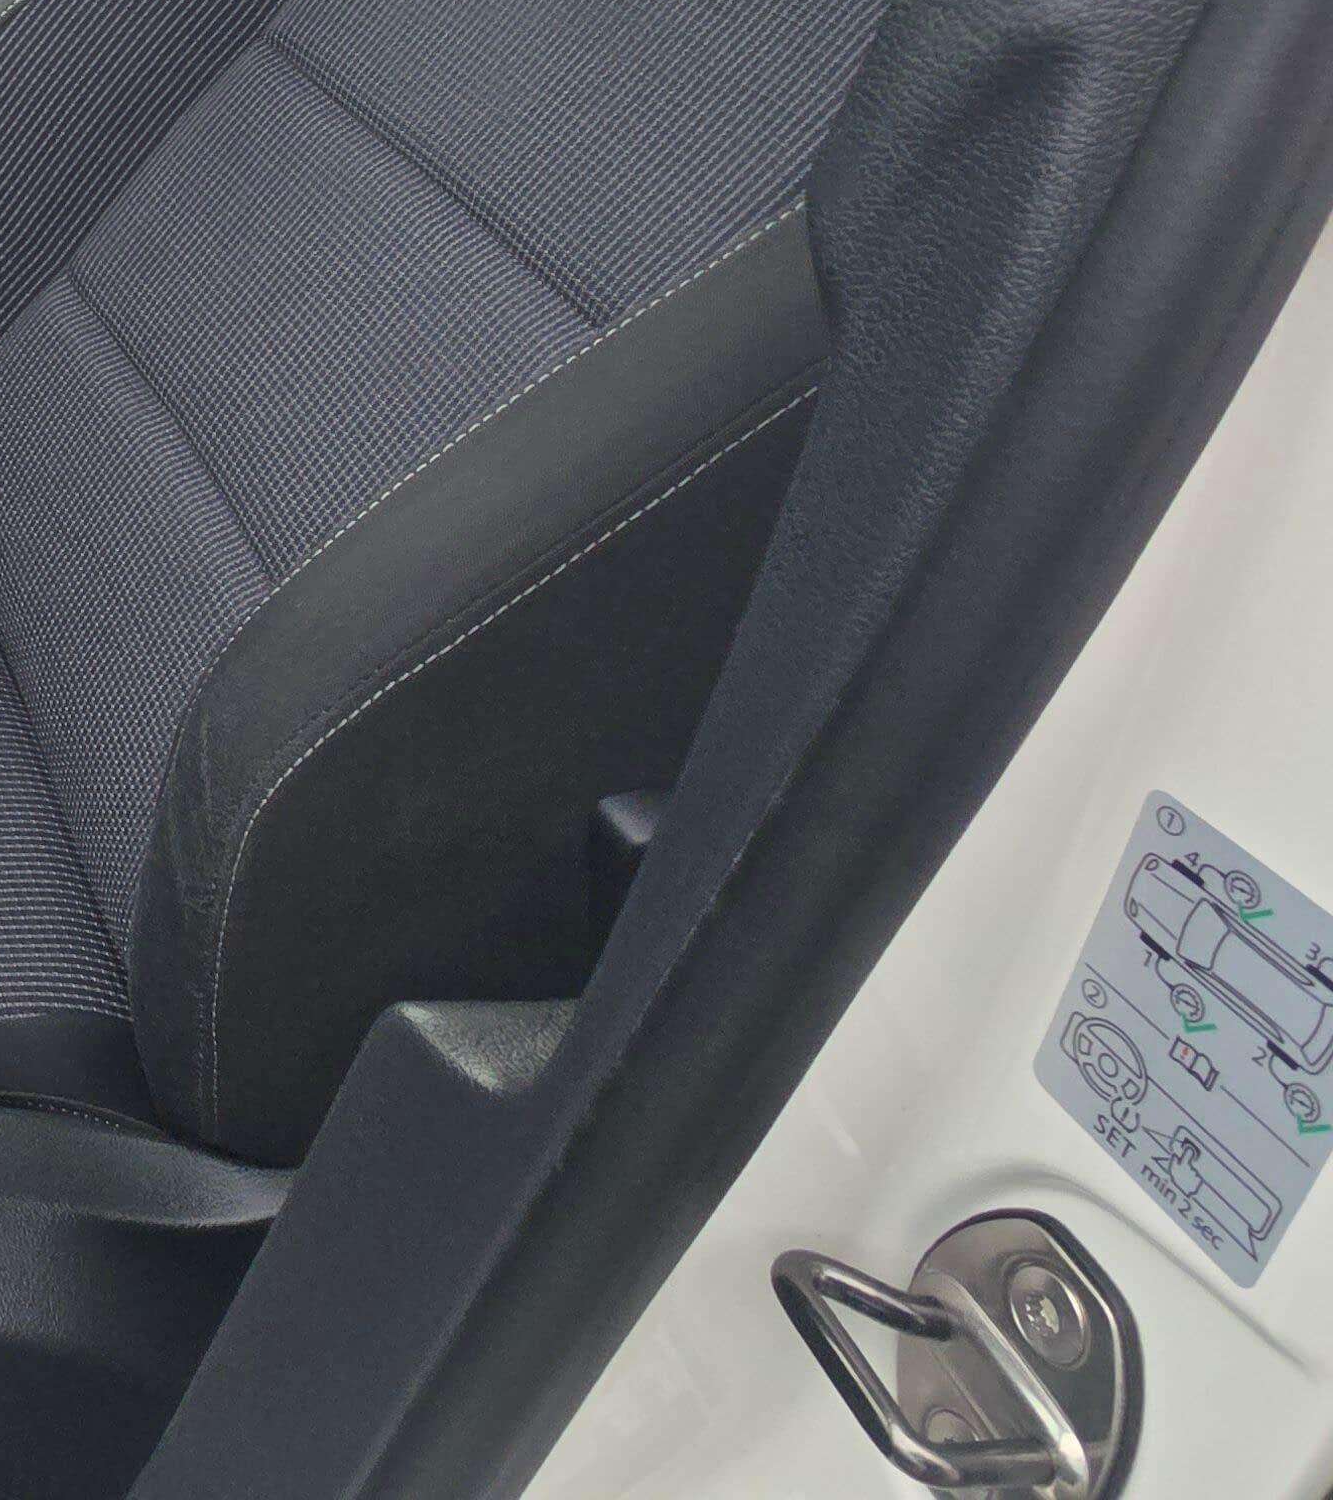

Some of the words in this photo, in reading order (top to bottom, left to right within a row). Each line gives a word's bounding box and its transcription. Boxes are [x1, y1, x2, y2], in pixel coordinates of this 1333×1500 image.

[1184, 851, 1200, 867] 4
[1144, 949, 1153, 967] 1
[1304, 941, 1322, 962] 3
[1250, 1046, 1268, 1067] 2
[1093, 1114, 1137, 1158] SET
[1140, 1164, 1177, 1204] min
[1177, 1198, 1192, 1220] 2
[1191, 1216, 1225, 1250] sec
